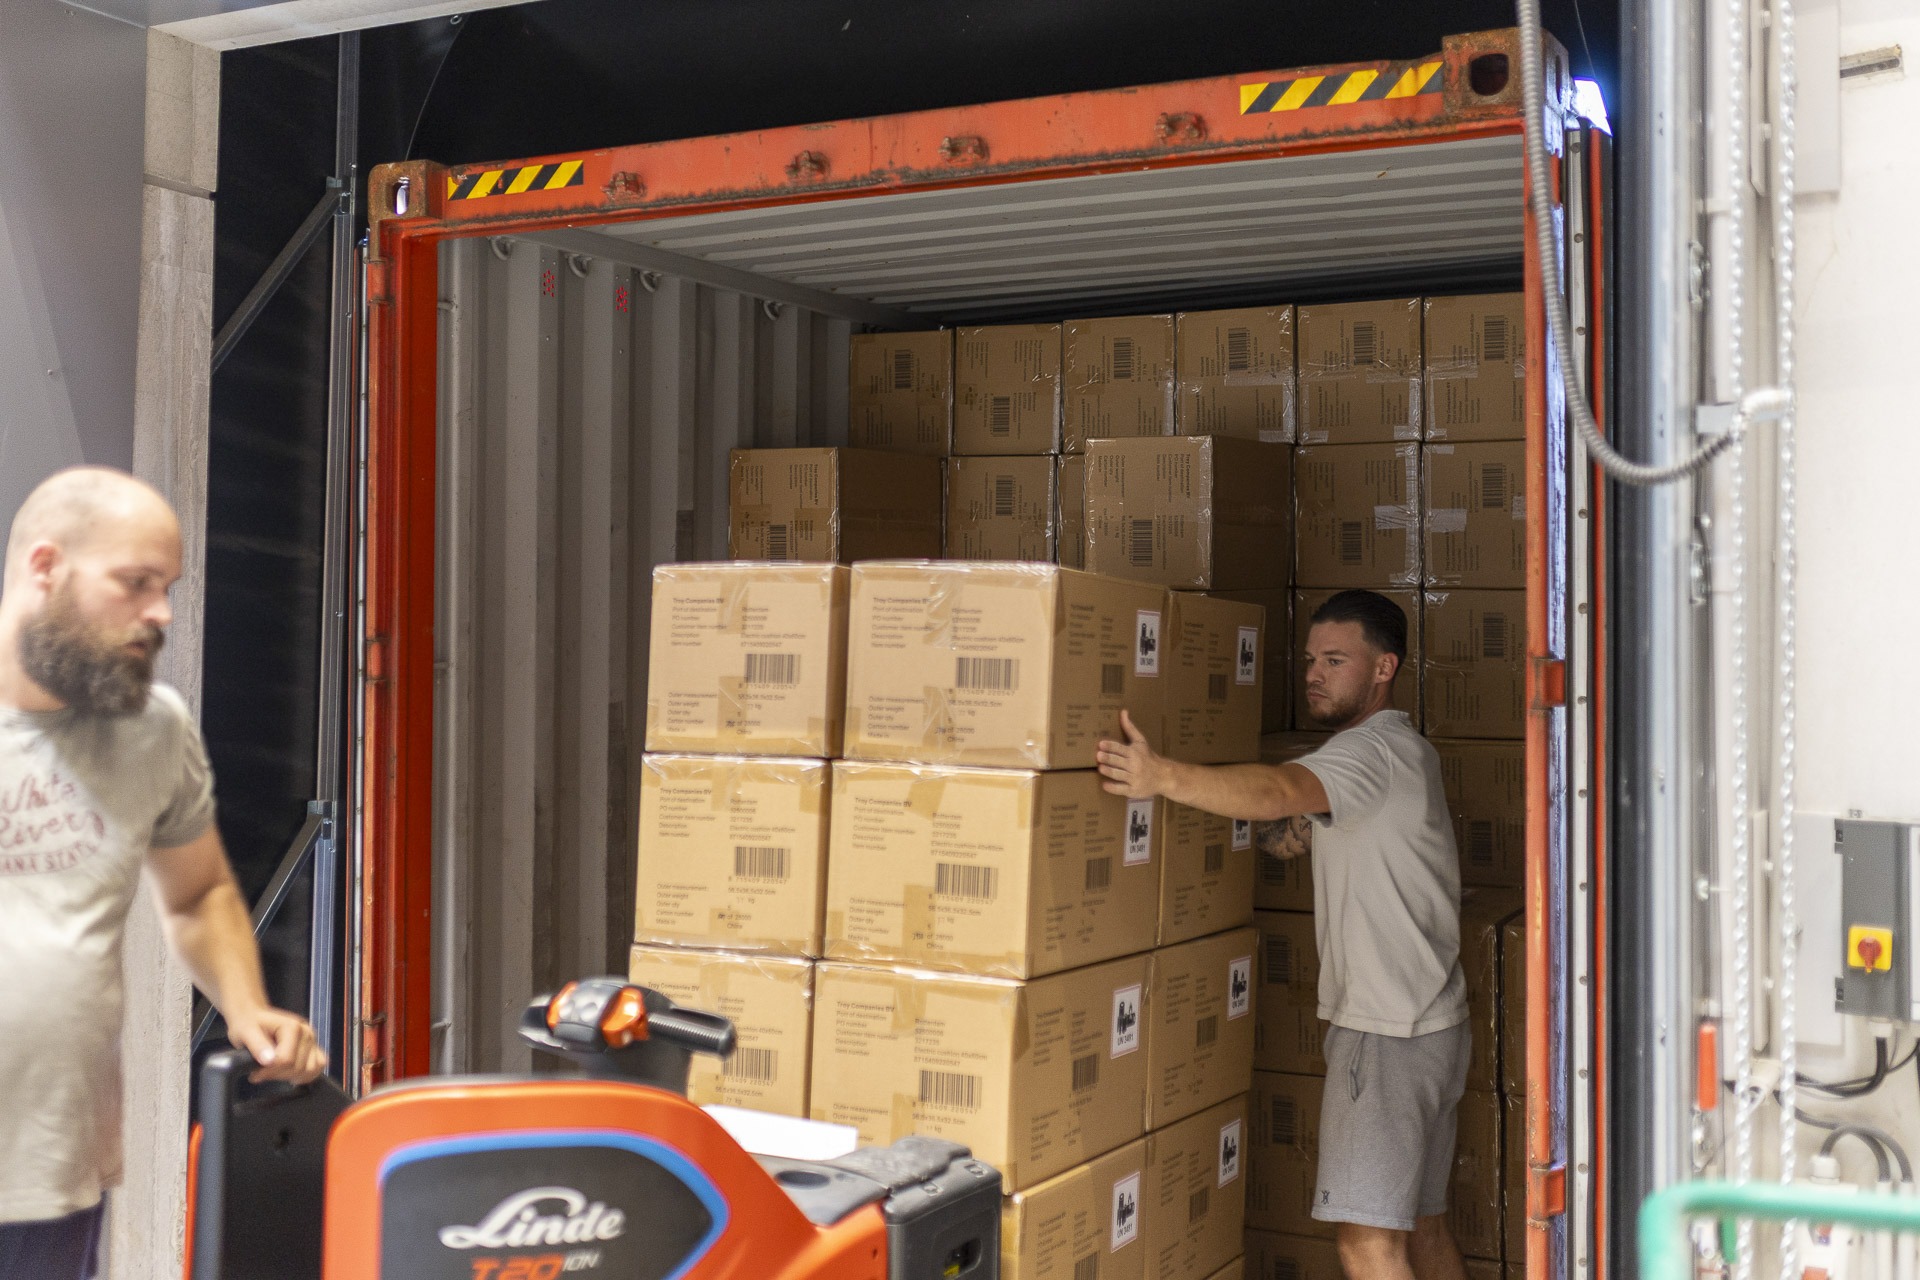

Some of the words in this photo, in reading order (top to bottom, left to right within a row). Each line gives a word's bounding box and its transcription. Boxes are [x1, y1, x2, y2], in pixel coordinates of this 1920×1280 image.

[662, 984, 691, 992] Companies
[852, 1003, 884, 1012] Companies
[438, 1185, 625, 1249] Linde
[563, 1251, 600, 1272] ION
